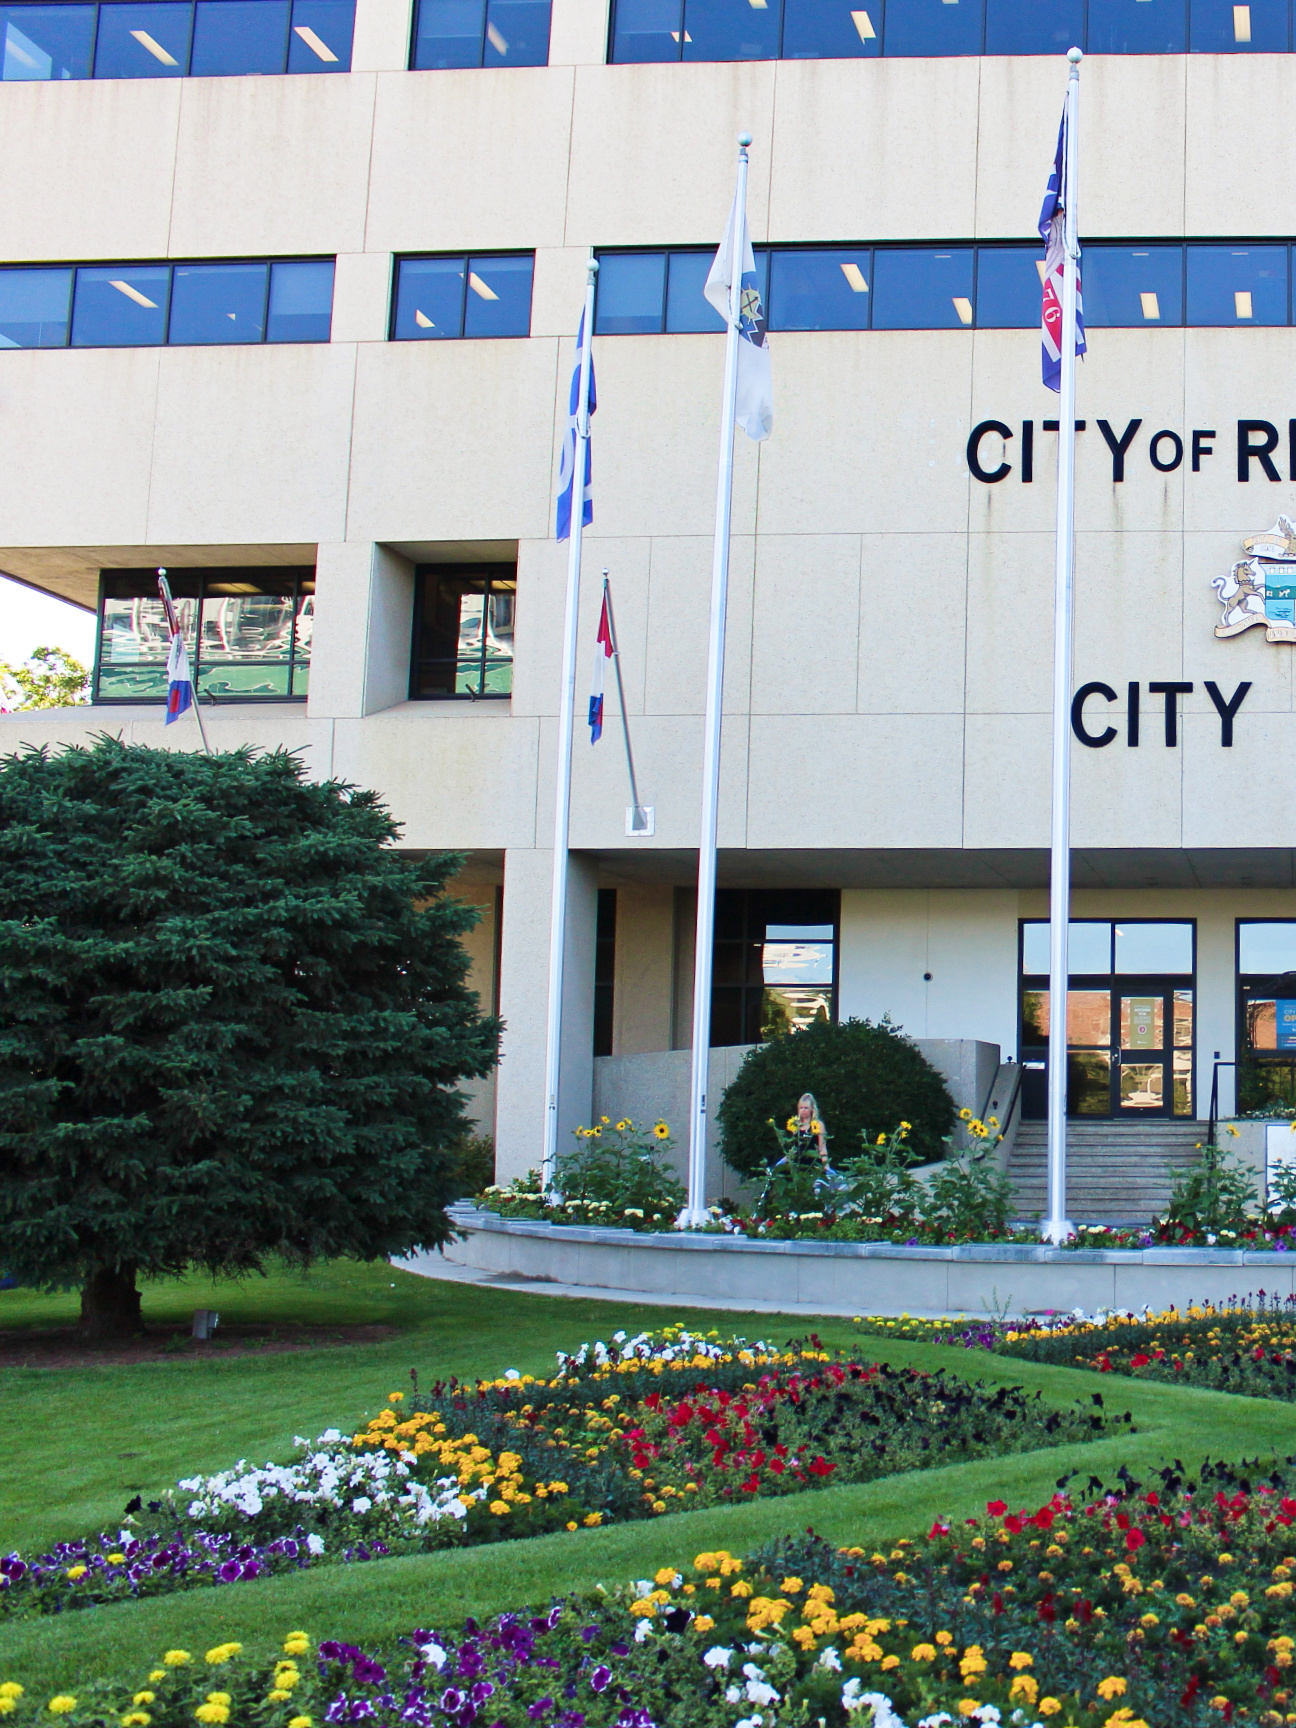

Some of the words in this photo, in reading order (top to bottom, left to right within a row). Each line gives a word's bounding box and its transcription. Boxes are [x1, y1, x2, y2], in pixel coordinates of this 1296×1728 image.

[966, 418, 1143, 484] CIY
[1149, 429, 1217, 473] OF
[1071, 681, 1253, 748] CITY
